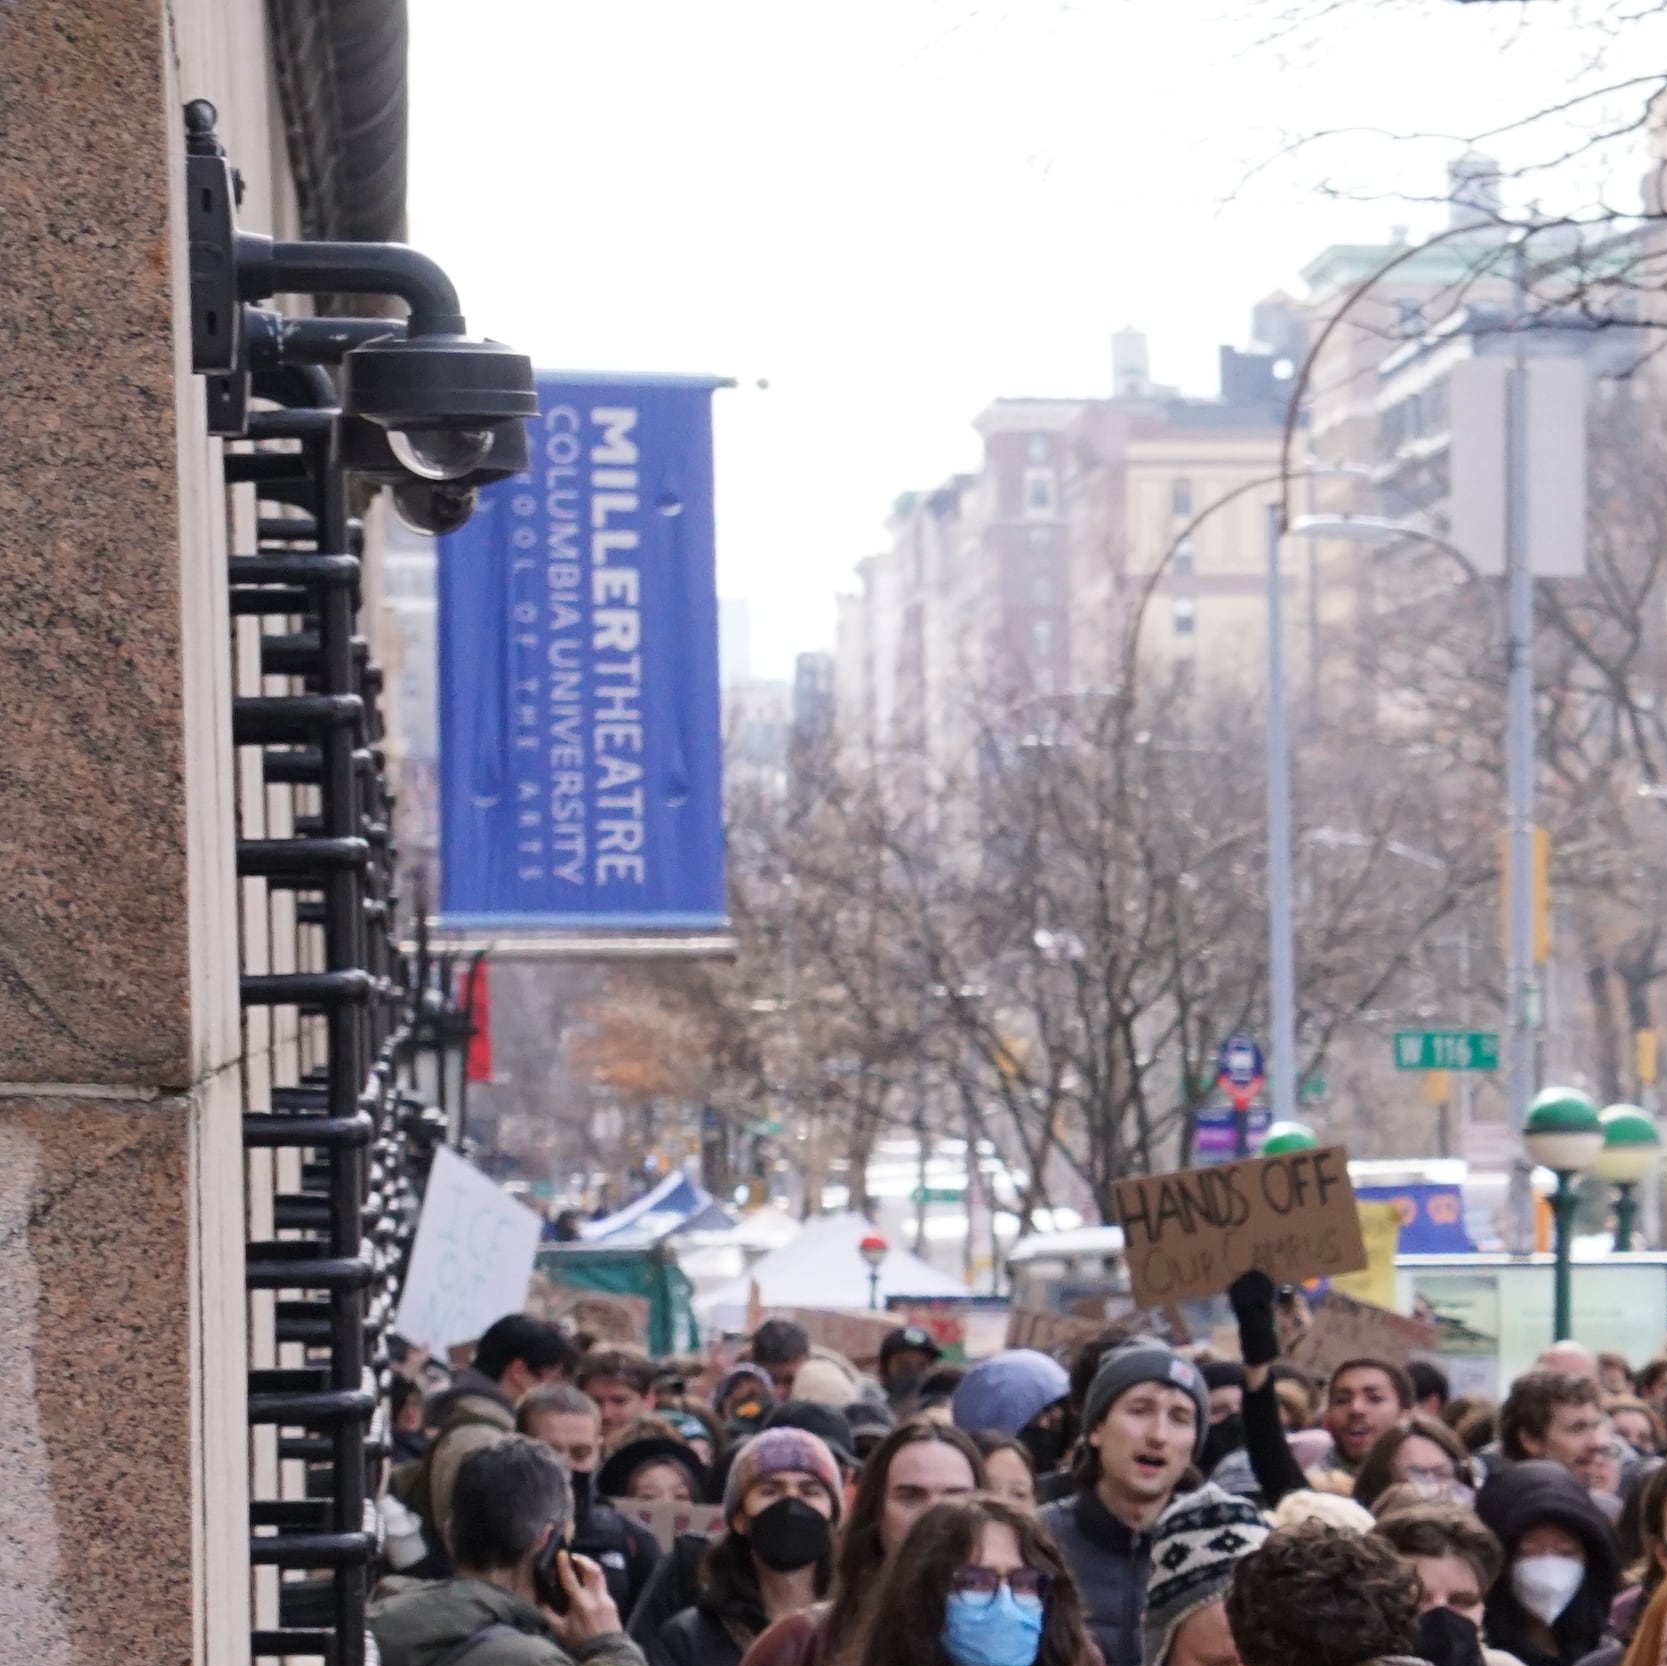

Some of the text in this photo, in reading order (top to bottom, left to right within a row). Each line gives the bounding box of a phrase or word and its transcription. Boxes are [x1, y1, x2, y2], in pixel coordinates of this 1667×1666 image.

[546, 404, 587, 886] COLUMBIA UNIVERSITY
[1400, 1037, 1422, 1067] W
[1432, 1036, 1471, 1067] 116
[1116, 1153, 1339, 1248] HANDS OFF
